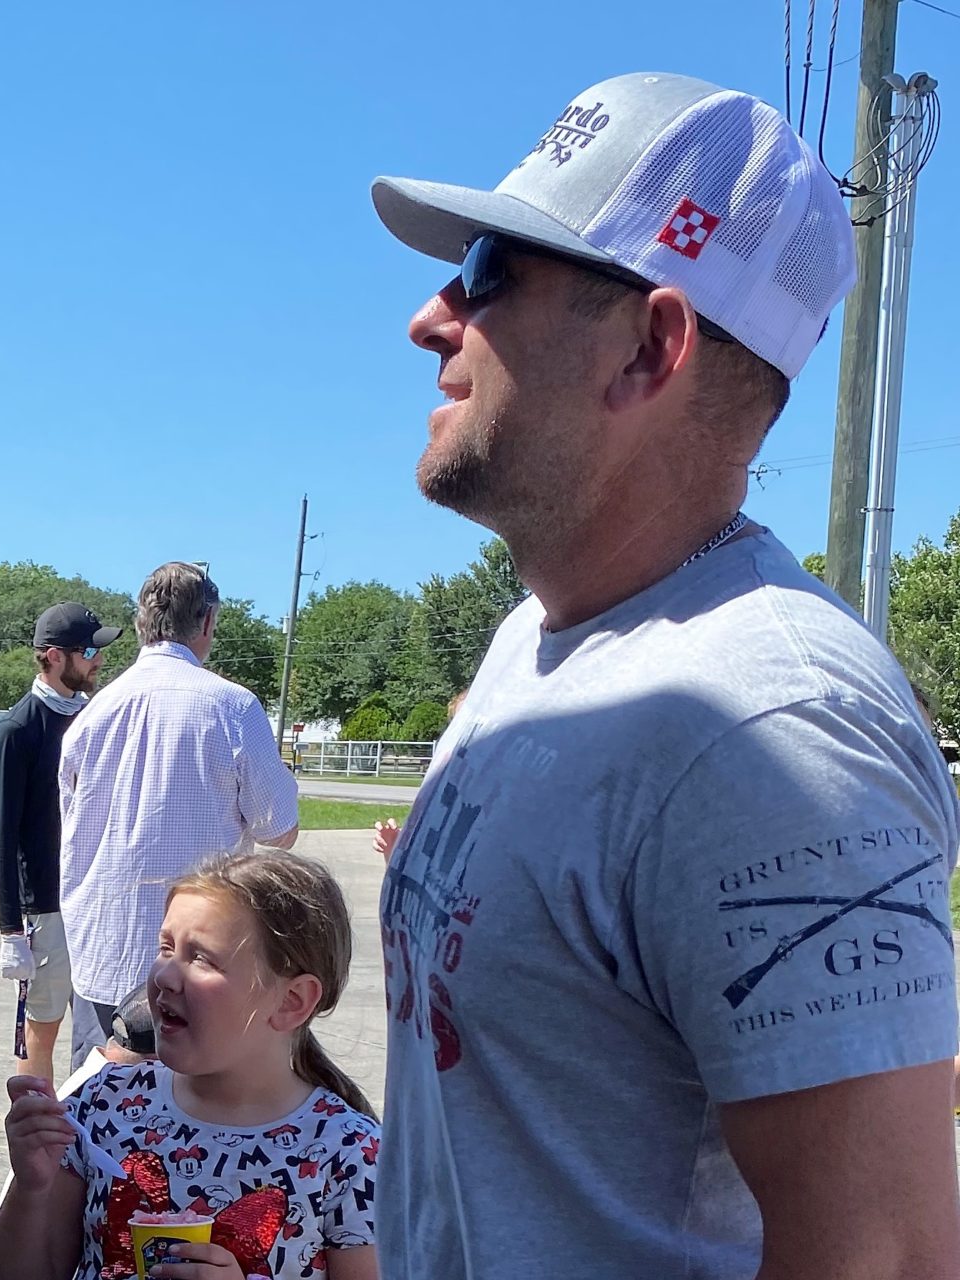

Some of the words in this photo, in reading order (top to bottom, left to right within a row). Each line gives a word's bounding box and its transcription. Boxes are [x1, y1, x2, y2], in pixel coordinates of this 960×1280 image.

[718, 837, 850, 894] GRUNT
[861, 826, 930, 851] STYL
[823, 929, 904, 977] GS
[729, 1007, 796, 1034] THIS
[805, 985, 887, 1016] WE'LL
